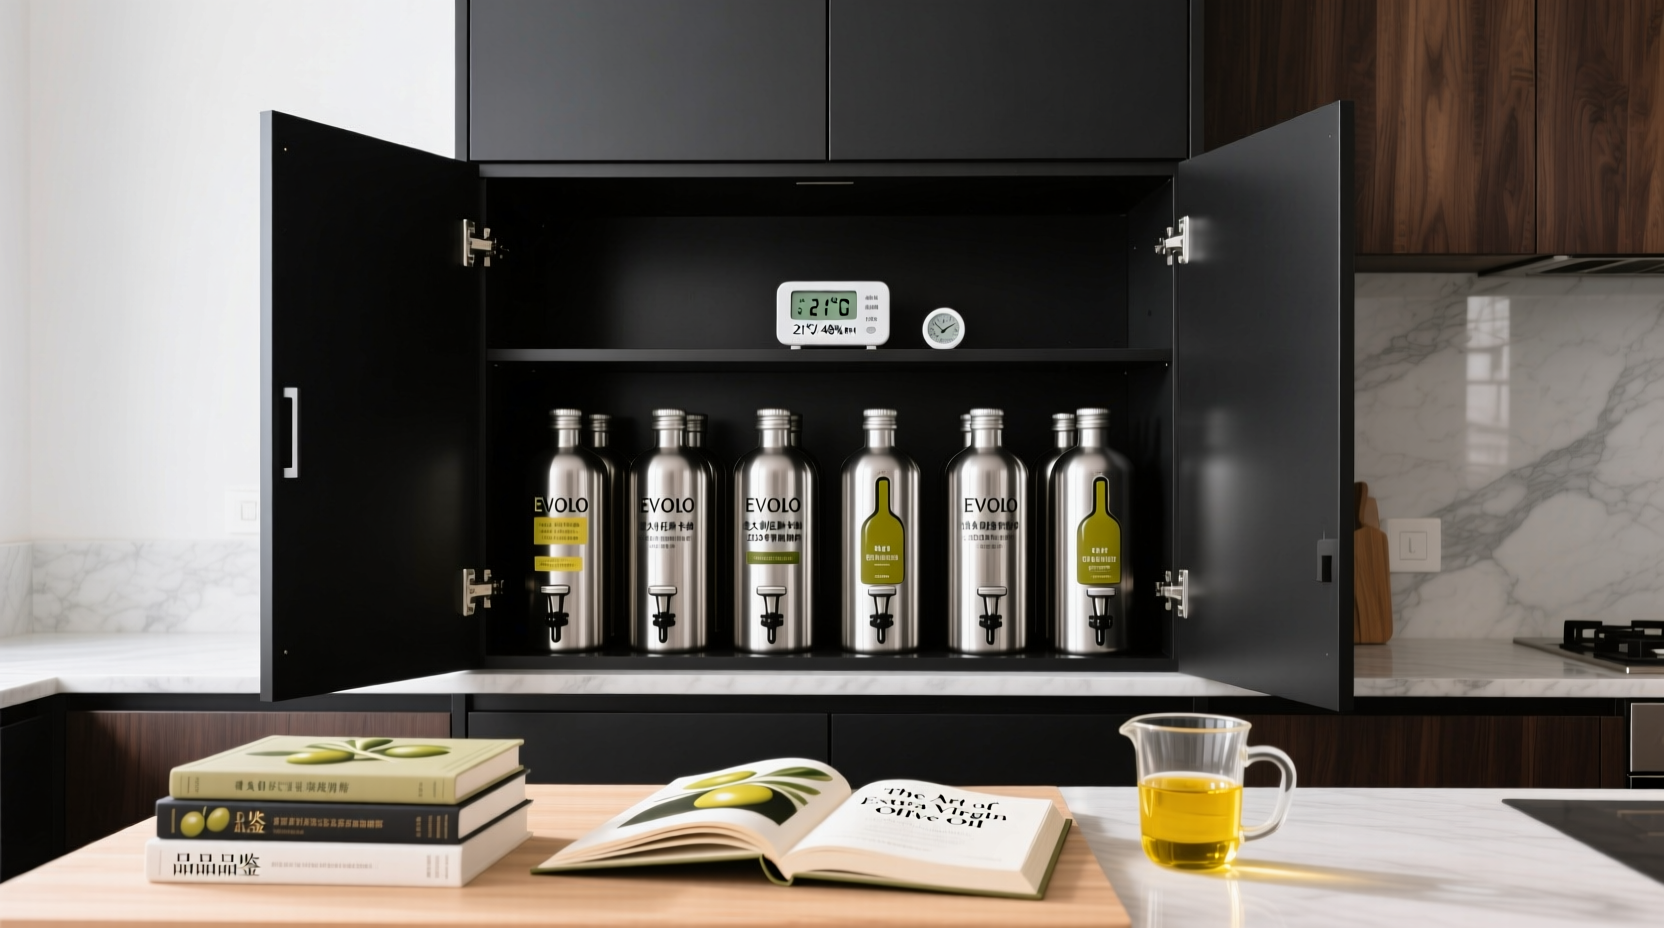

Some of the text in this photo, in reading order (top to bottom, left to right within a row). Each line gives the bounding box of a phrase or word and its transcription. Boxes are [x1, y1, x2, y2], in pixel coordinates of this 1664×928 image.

[534, 497, 589, 513] EVOLO
[639, 497, 695, 514] EVOLO
[745, 497, 802, 513] EVOLO
[964, 497, 1018, 513] EVOLO
[884, 787, 1000, 811] The Art of
[860, 796, 1007, 821] Extra Virgin
[875, 805, 940, 822] Olive
[946, 817, 984, 829] Oil
